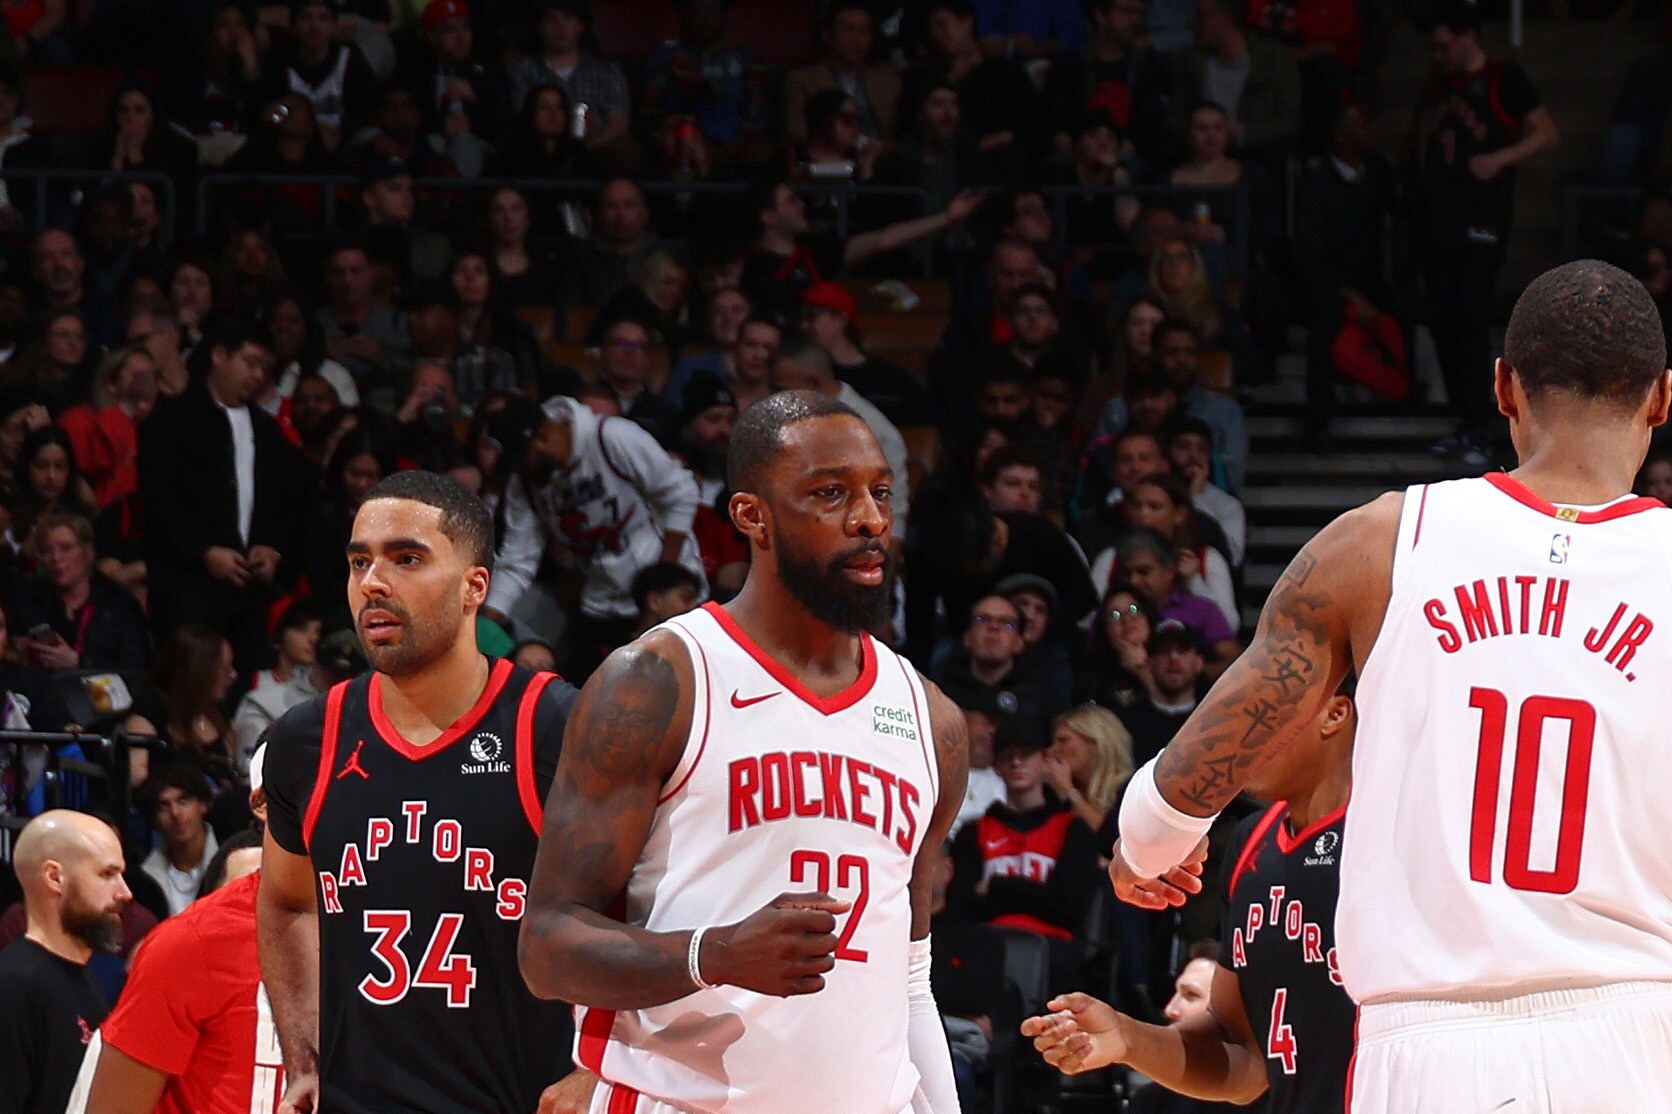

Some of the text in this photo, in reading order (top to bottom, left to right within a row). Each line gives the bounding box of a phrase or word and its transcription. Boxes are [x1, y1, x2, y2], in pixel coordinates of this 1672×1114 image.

[1423, 576, 1653, 683] SMITH JR.
[873, 703, 914, 725] credit
[873, 718, 917, 740] karma
[461, 761, 511, 774] Sun Life
[728, 751, 920, 856] ROCKETS
[1468, 686, 1596, 895] 10
[319, 801, 527, 920] RAPTORS
[358, 910, 477, 1007] 34
[1268, 988, 1297, 1074] 4
